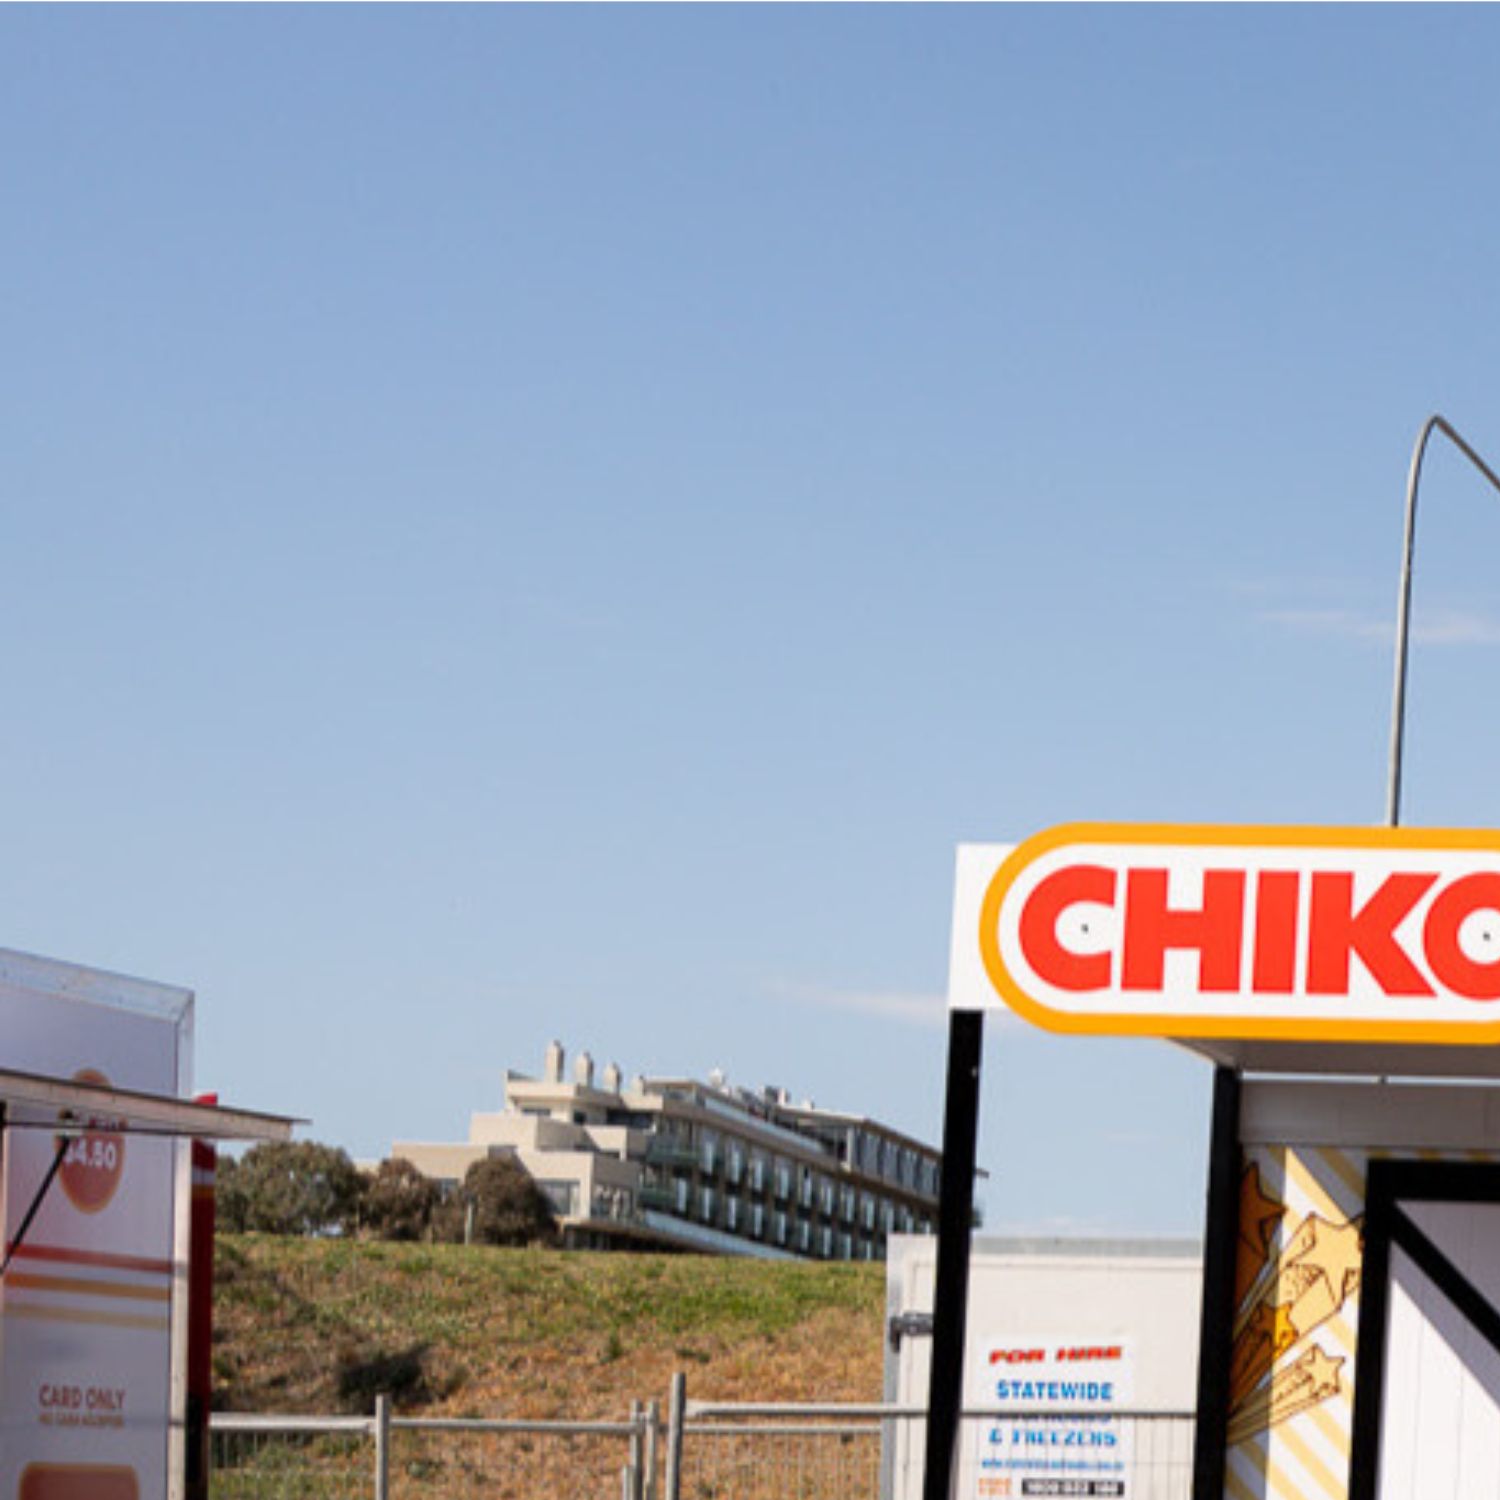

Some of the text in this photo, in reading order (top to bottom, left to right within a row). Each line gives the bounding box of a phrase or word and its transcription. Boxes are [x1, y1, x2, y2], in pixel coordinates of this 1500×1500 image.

[38, 1383, 127, 1410] CARD ONLY
[996, 1378, 1114, 1402] STATEWIDE
